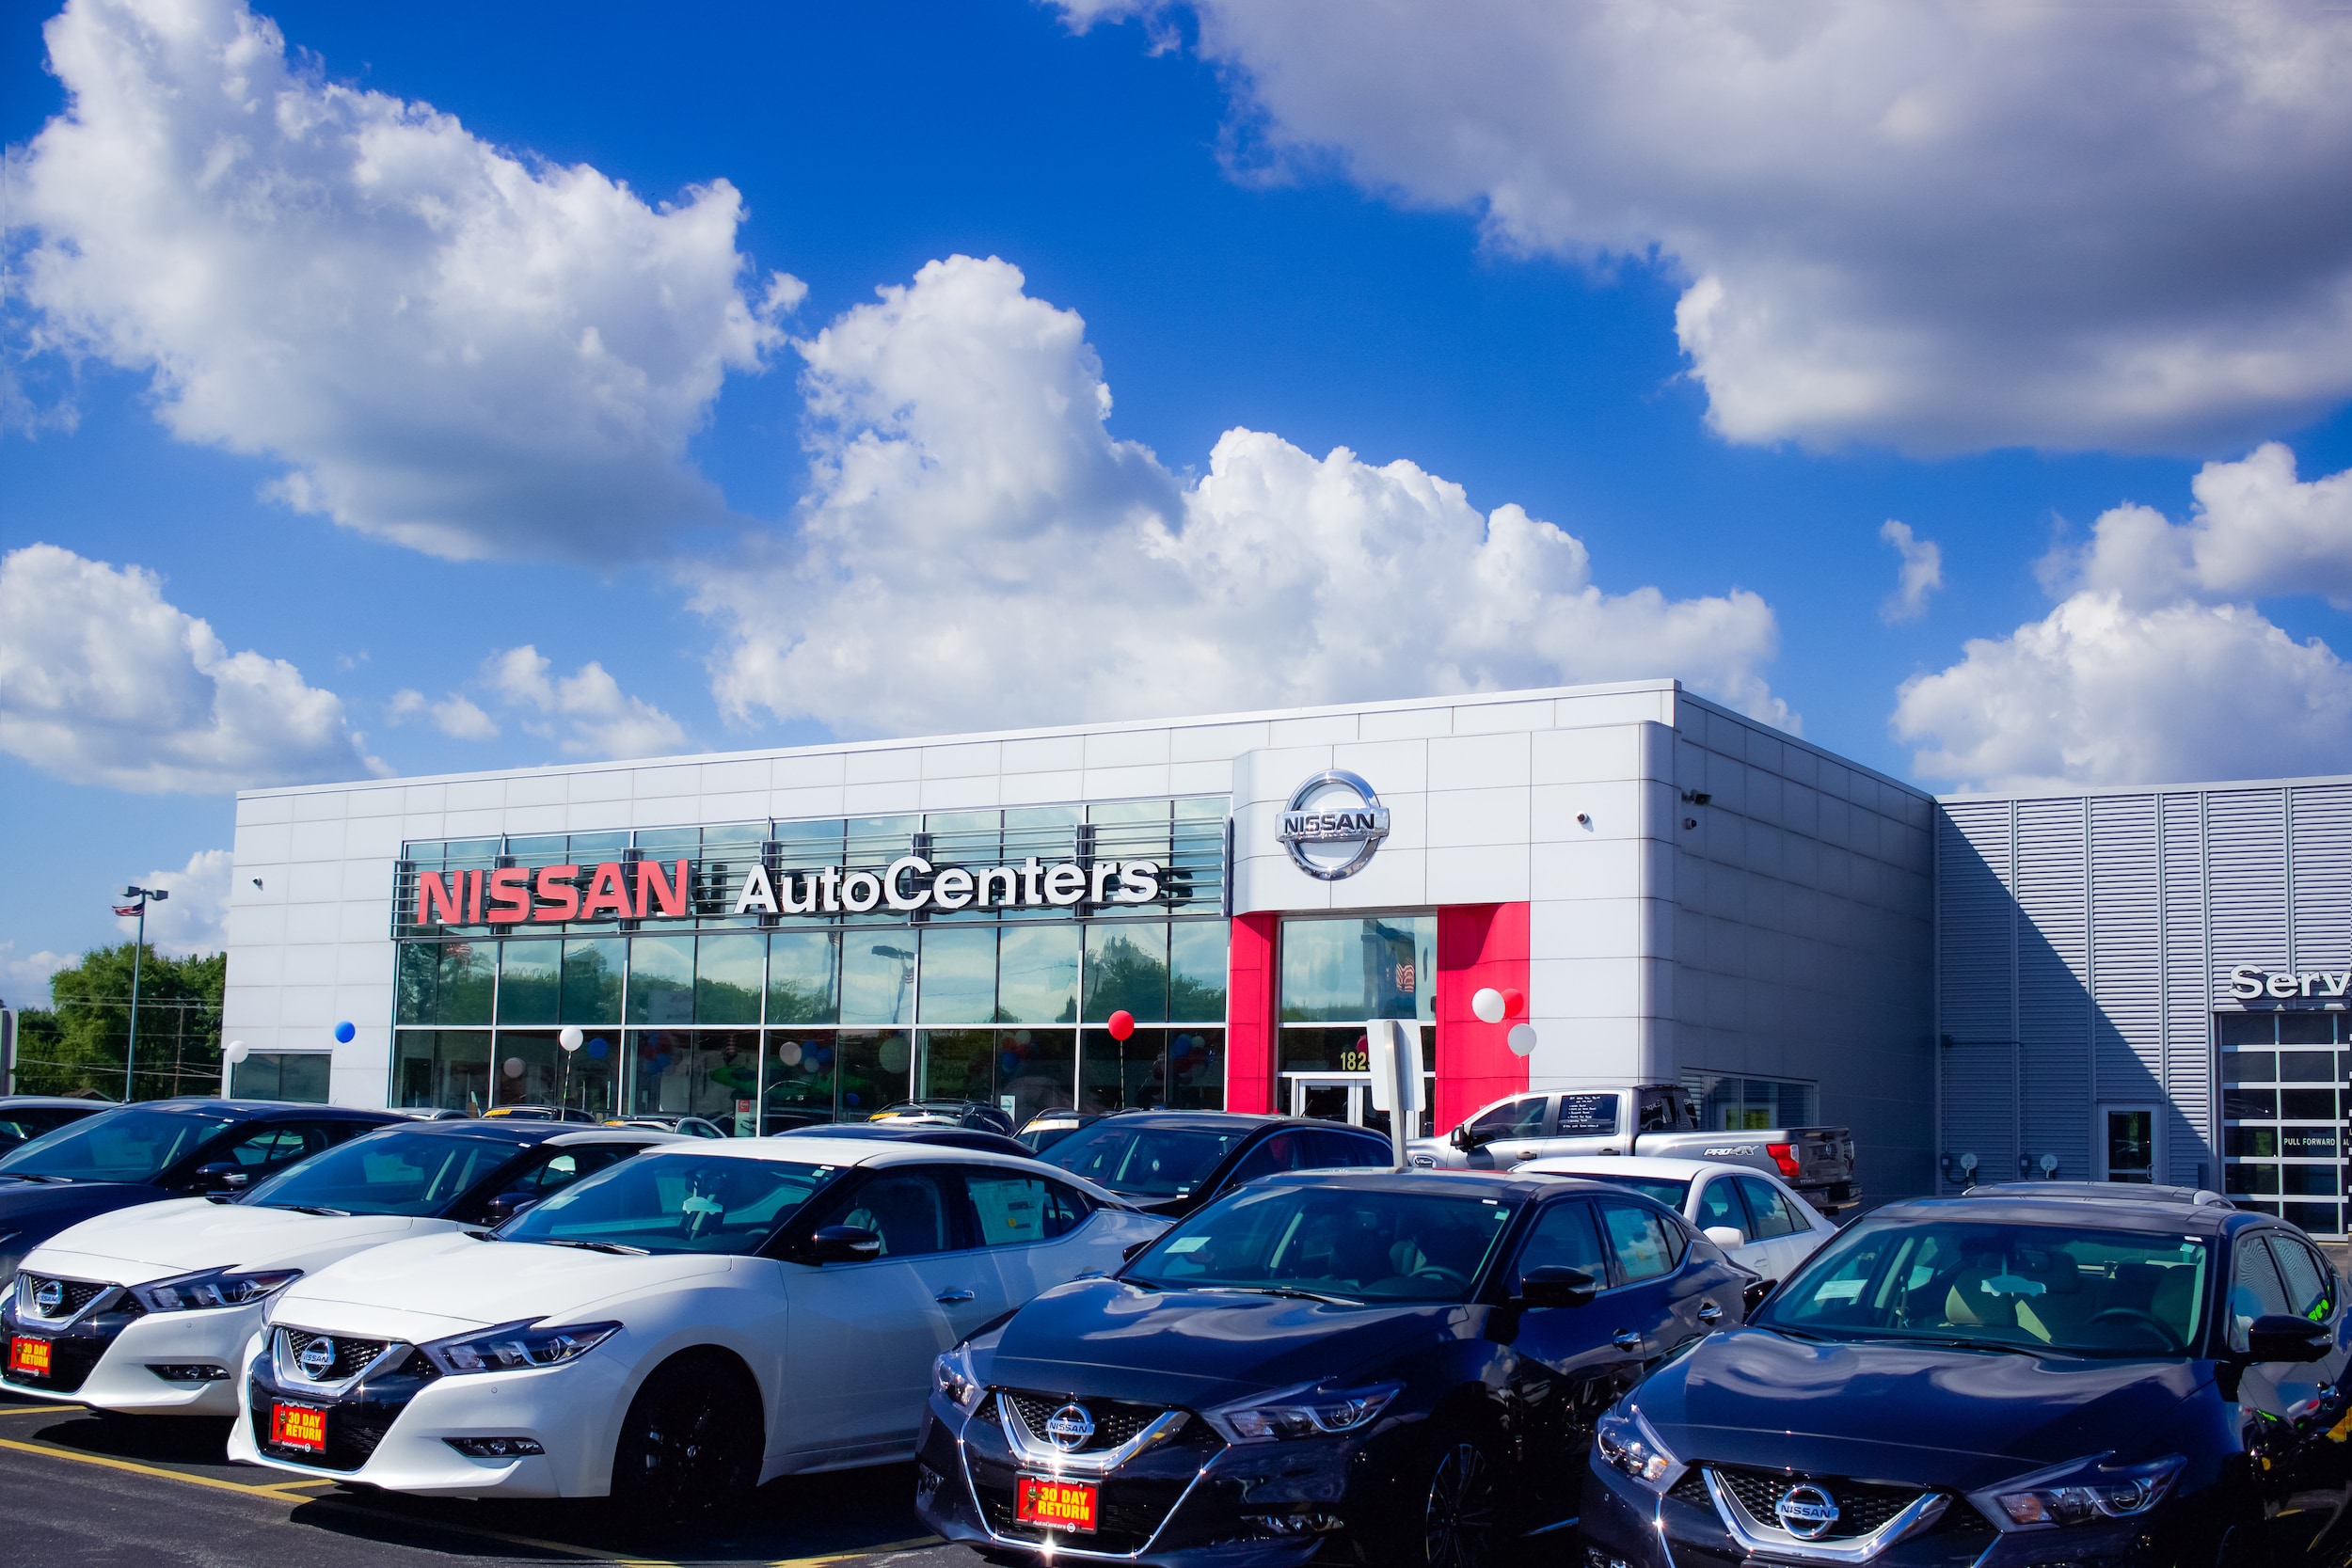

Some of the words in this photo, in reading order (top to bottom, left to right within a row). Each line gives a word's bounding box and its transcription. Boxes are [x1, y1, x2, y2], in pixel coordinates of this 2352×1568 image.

[1284, 814, 1375, 833] NISSAN
[417, 859, 690, 925] NISSAN
[733, 856, 1161, 914] AutoCenters
[2228, 964, 2352, 999] Serv
[1340, 1051, 1371, 1070] 182
[2283, 1137, 2300, 1146] PULL
[2302, 1137, 2336, 1146] FORWARD
[23, 1342, 33, 1354] 30
[34, 1344, 48, 1356] DAY
[21, 1353, 49, 1368] RETURN
[288, 1411, 300, 1424] 30
[302, 1414, 321, 1428] DAY
[1049, 1421, 1088, 1433] NISSAN
[285, 1423, 322, 1442] RETURN
[1041, 1487, 1057, 1501] 30
[1061, 1489, 1088, 1505] DAY
[1038, 1499, 1089, 1521] RETURN
[1781, 1504, 1831, 1518] NISSAN
